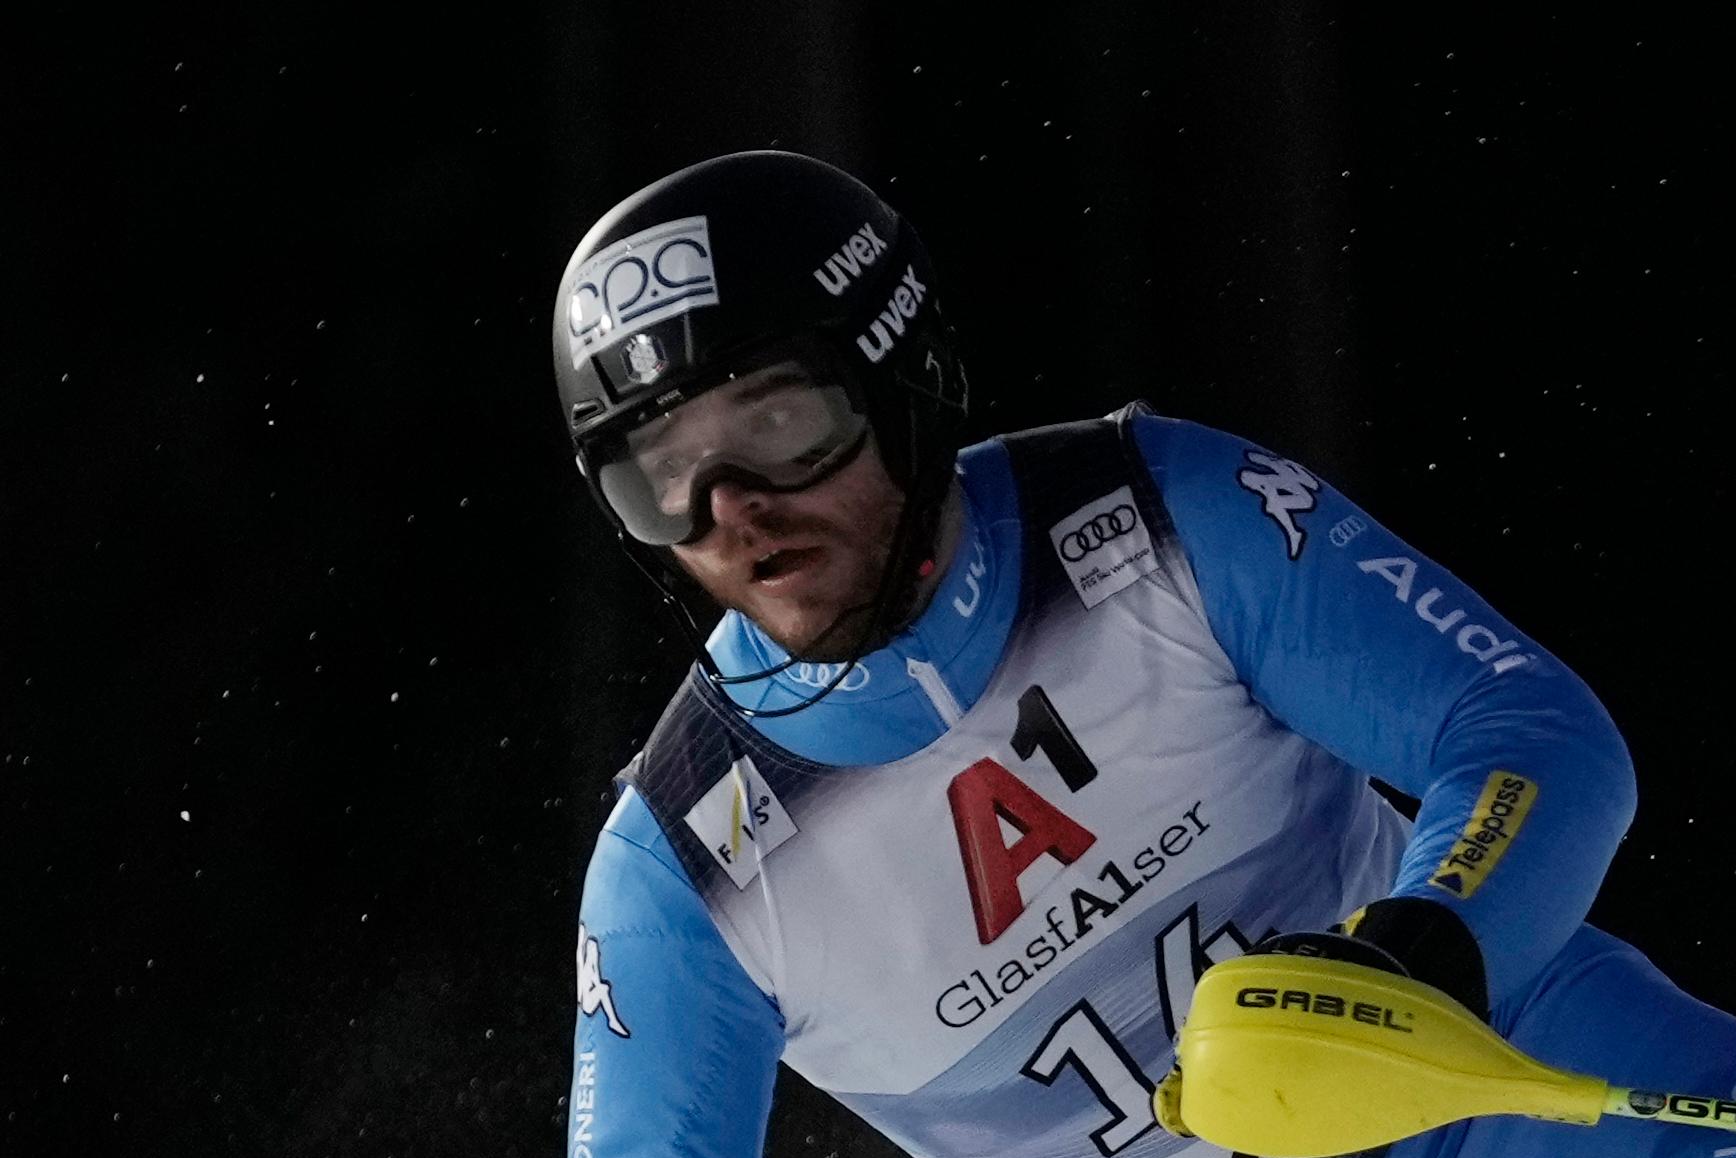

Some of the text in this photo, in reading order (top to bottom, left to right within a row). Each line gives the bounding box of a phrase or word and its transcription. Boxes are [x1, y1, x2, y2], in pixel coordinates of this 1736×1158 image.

[813, 222, 888, 296] uvex
[856, 263, 927, 364] uvex
[1357, 556, 1537, 673] Audi
[946, 684, 1098, 945] A1
[1448, 777, 1526, 870] Telepass
[1235, 986, 1414, 1034] GABEL
